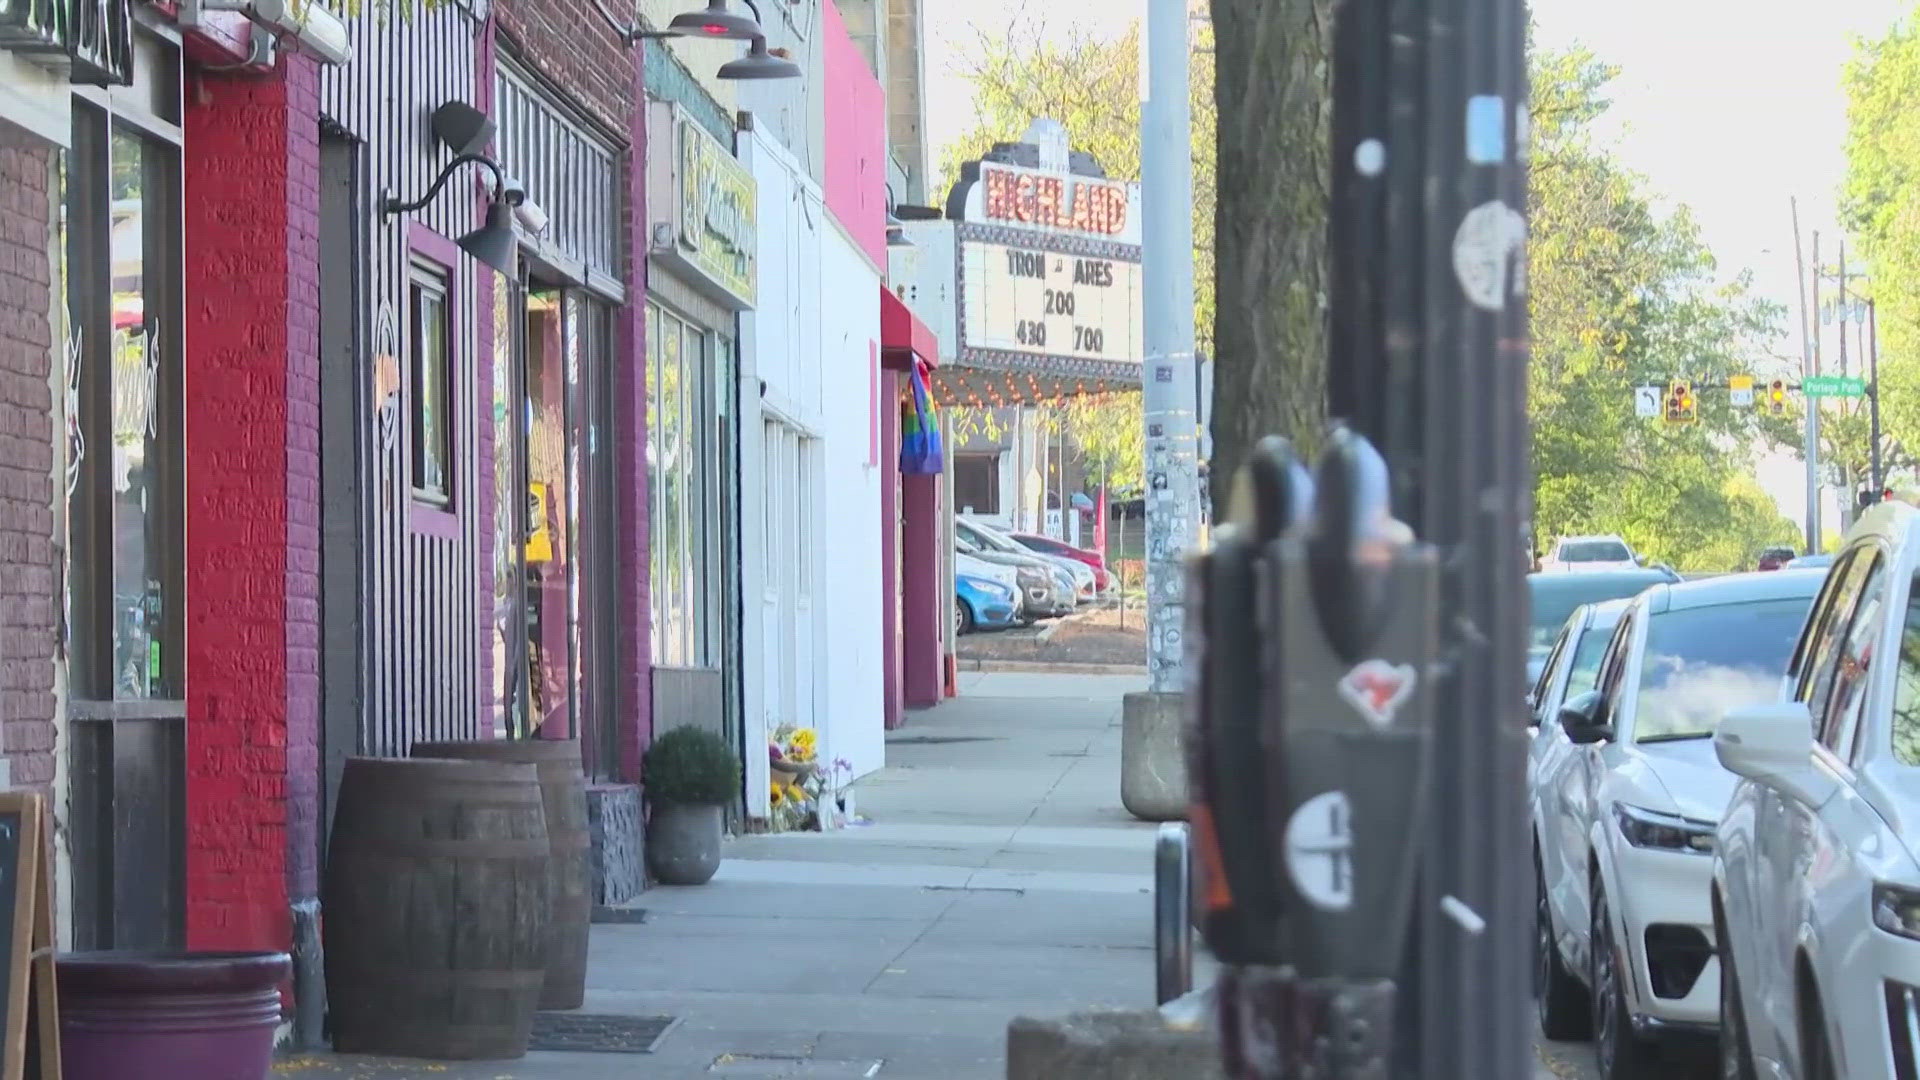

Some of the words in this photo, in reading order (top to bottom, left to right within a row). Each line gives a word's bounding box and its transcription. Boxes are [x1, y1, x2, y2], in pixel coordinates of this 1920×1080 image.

[985, 168, 1127, 235] HIGHLAND
[1006, 250, 1046, 280] TRON
[1074, 259, 1113, 287] ARES
[1045, 288, 1075, 316] 200
[1016, 320, 1046, 346] 430
[1074, 326, 1104, 353] 700
[1841, 381, 1861, 394] Path
